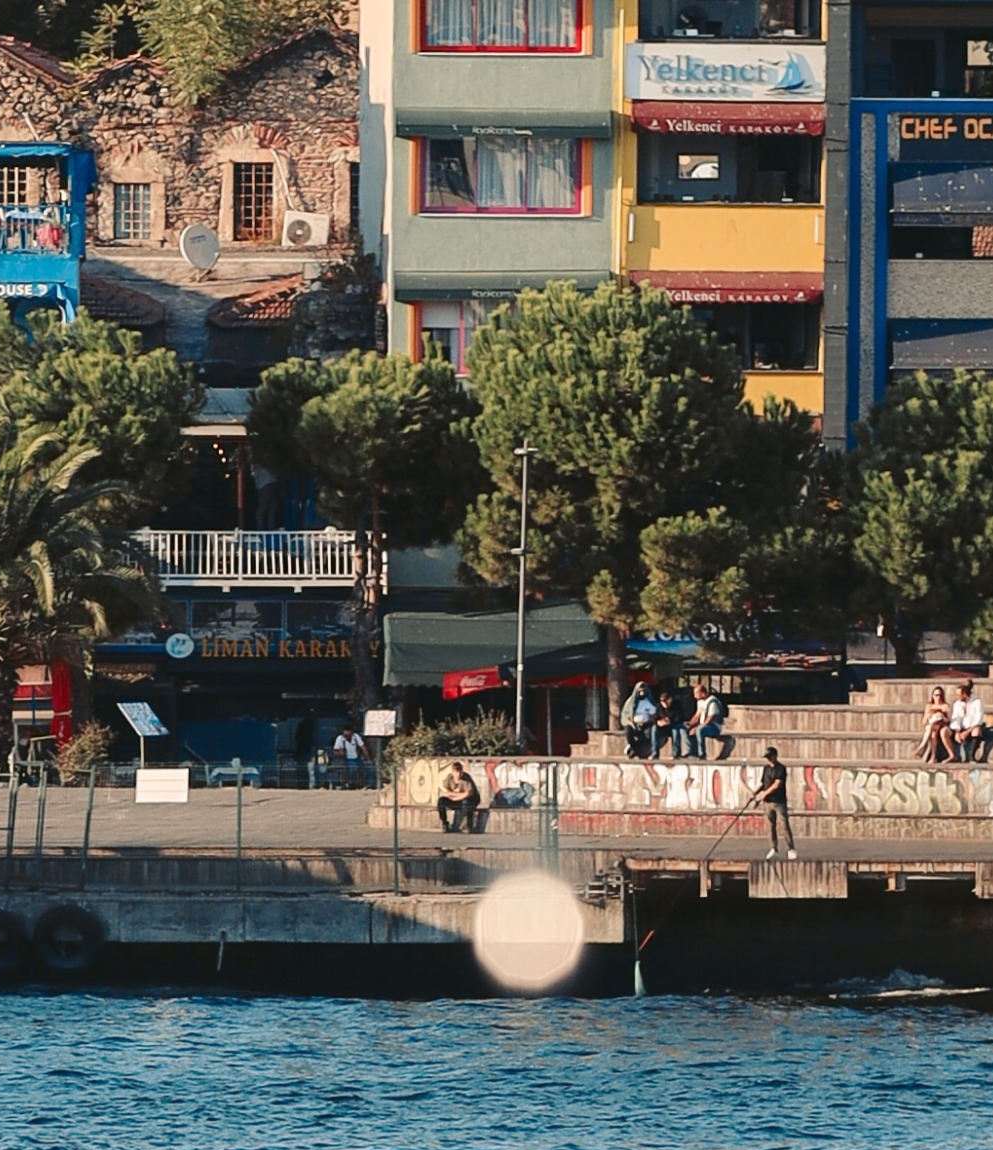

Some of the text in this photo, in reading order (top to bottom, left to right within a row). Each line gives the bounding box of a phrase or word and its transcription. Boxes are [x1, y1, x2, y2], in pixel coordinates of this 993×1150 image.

[638, 55, 766, 82] Yelkenci
[666, 119, 722, 133] Yelkenci
[901, 118, 993, 139] CHEF OC
[666, 290, 721, 302] Yelkenci
[279, 640, 380, 659] KARAKY
